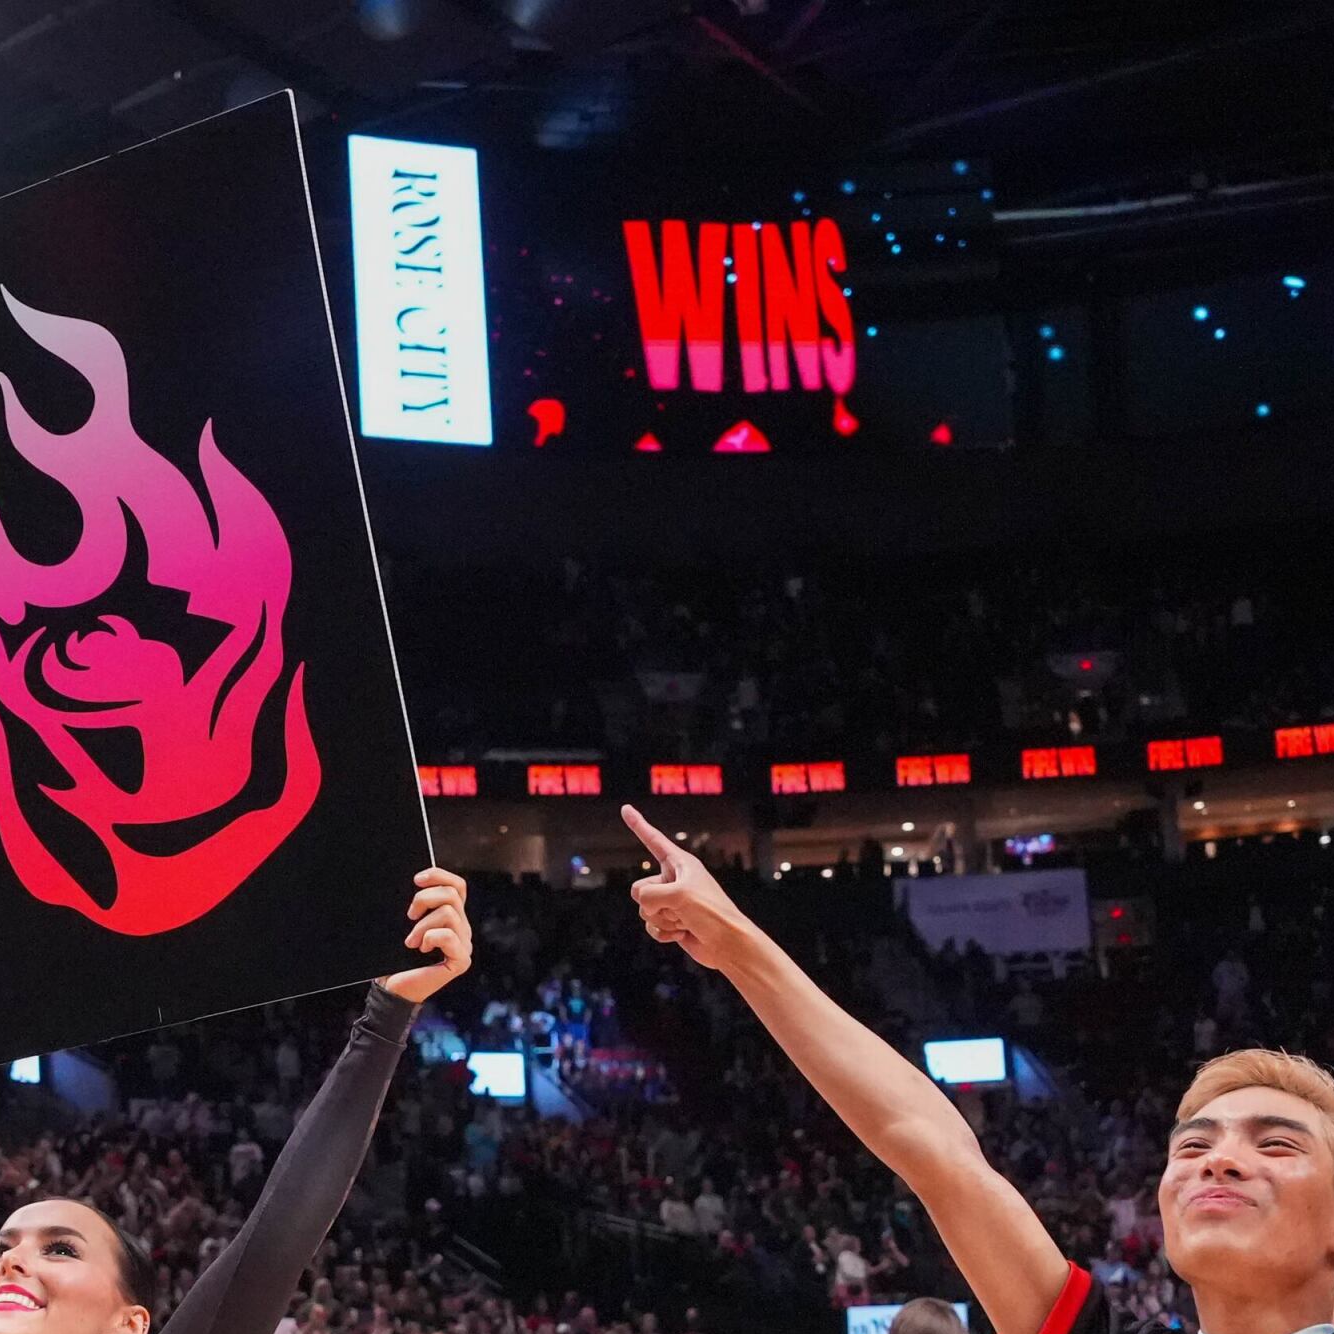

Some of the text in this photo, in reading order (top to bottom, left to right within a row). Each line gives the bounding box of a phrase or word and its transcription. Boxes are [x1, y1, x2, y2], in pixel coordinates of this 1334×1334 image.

[392, 168, 452, 425] ROSE CITY
[623, 218, 857, 394] WINS
